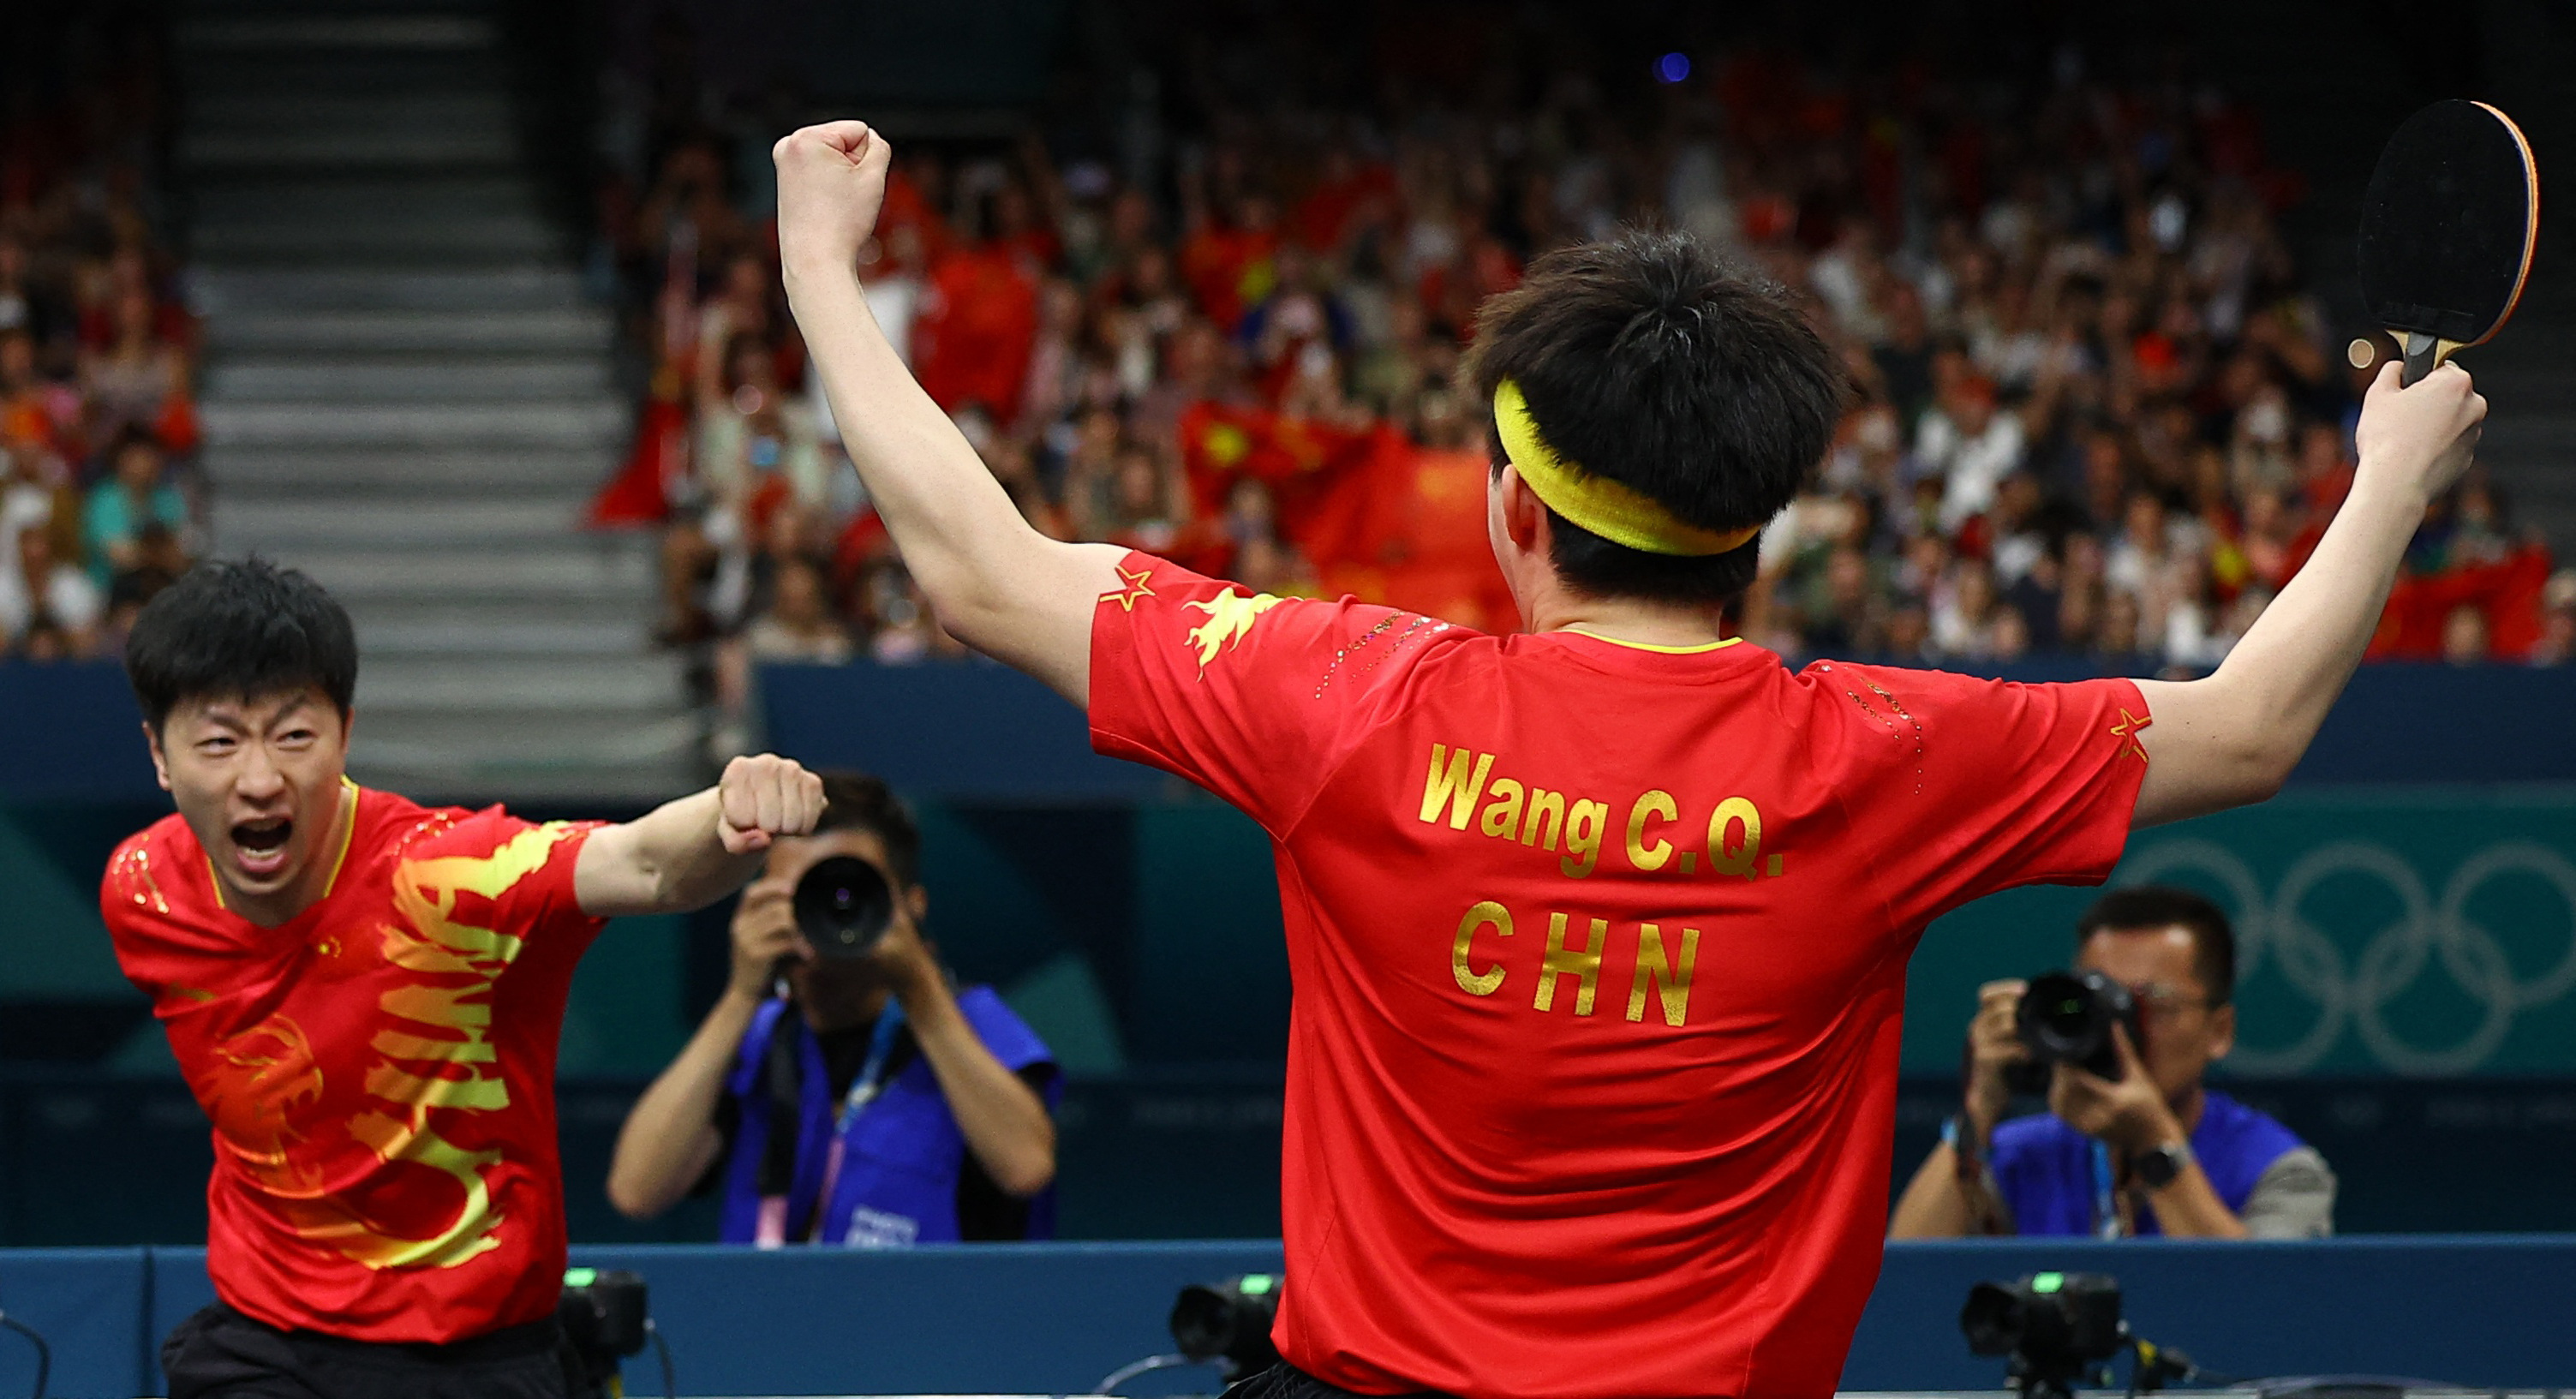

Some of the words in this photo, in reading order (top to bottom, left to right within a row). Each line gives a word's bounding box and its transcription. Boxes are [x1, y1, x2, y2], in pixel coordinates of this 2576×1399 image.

[1419, 743, 1609, 878] Wang
[1626, 789, 1783, 881] C.Q.
[1452, 900, 1700, 1027] CHN
